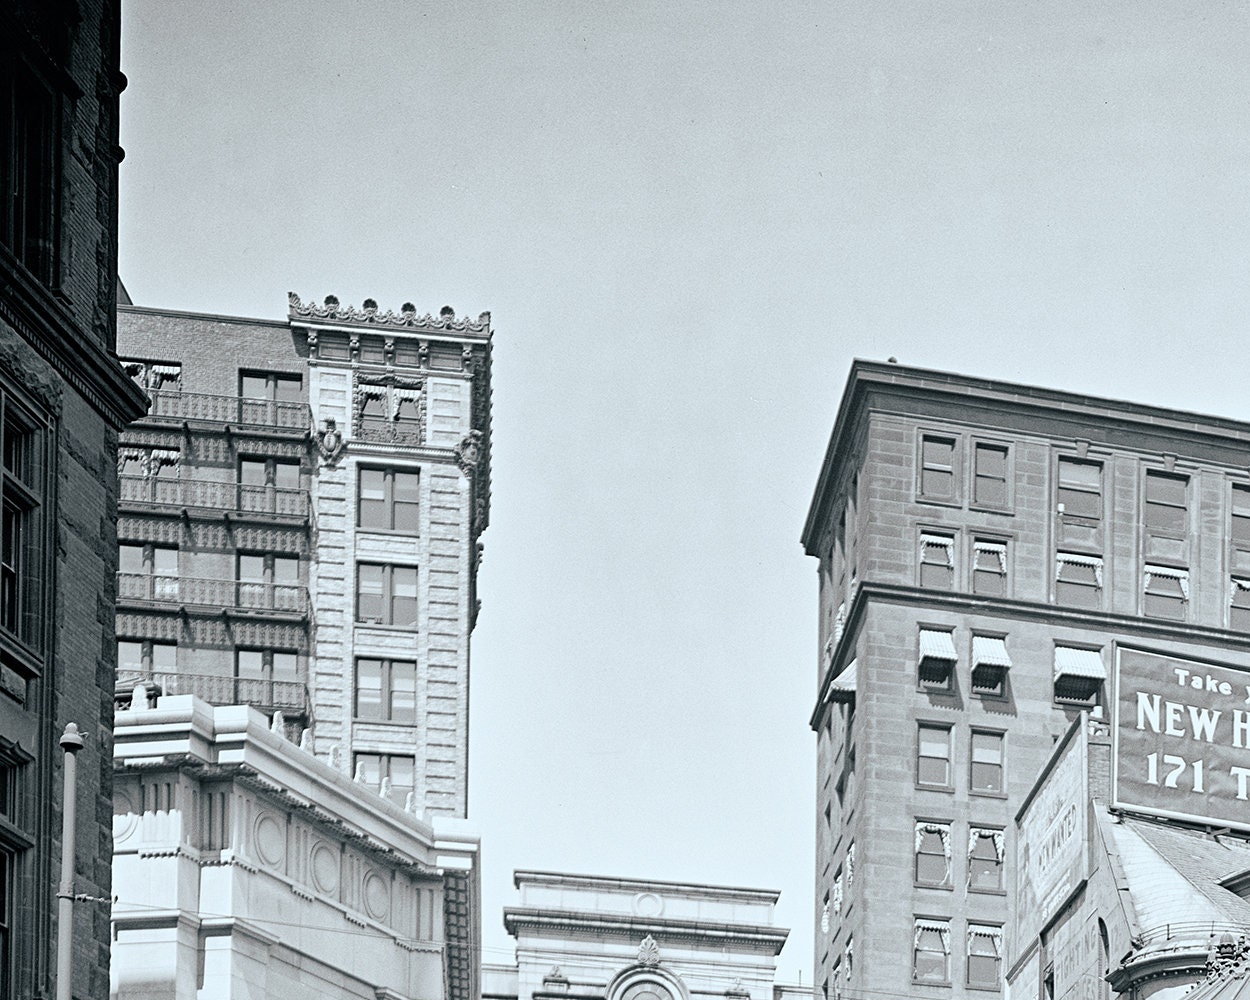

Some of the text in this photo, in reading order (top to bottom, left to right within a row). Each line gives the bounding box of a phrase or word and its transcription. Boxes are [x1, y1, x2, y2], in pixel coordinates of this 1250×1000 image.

[1174, 668, 1233, 696] Take
[1136, 691, 1223, 744] NEW
[1146, 751, 1205, 794] 171
